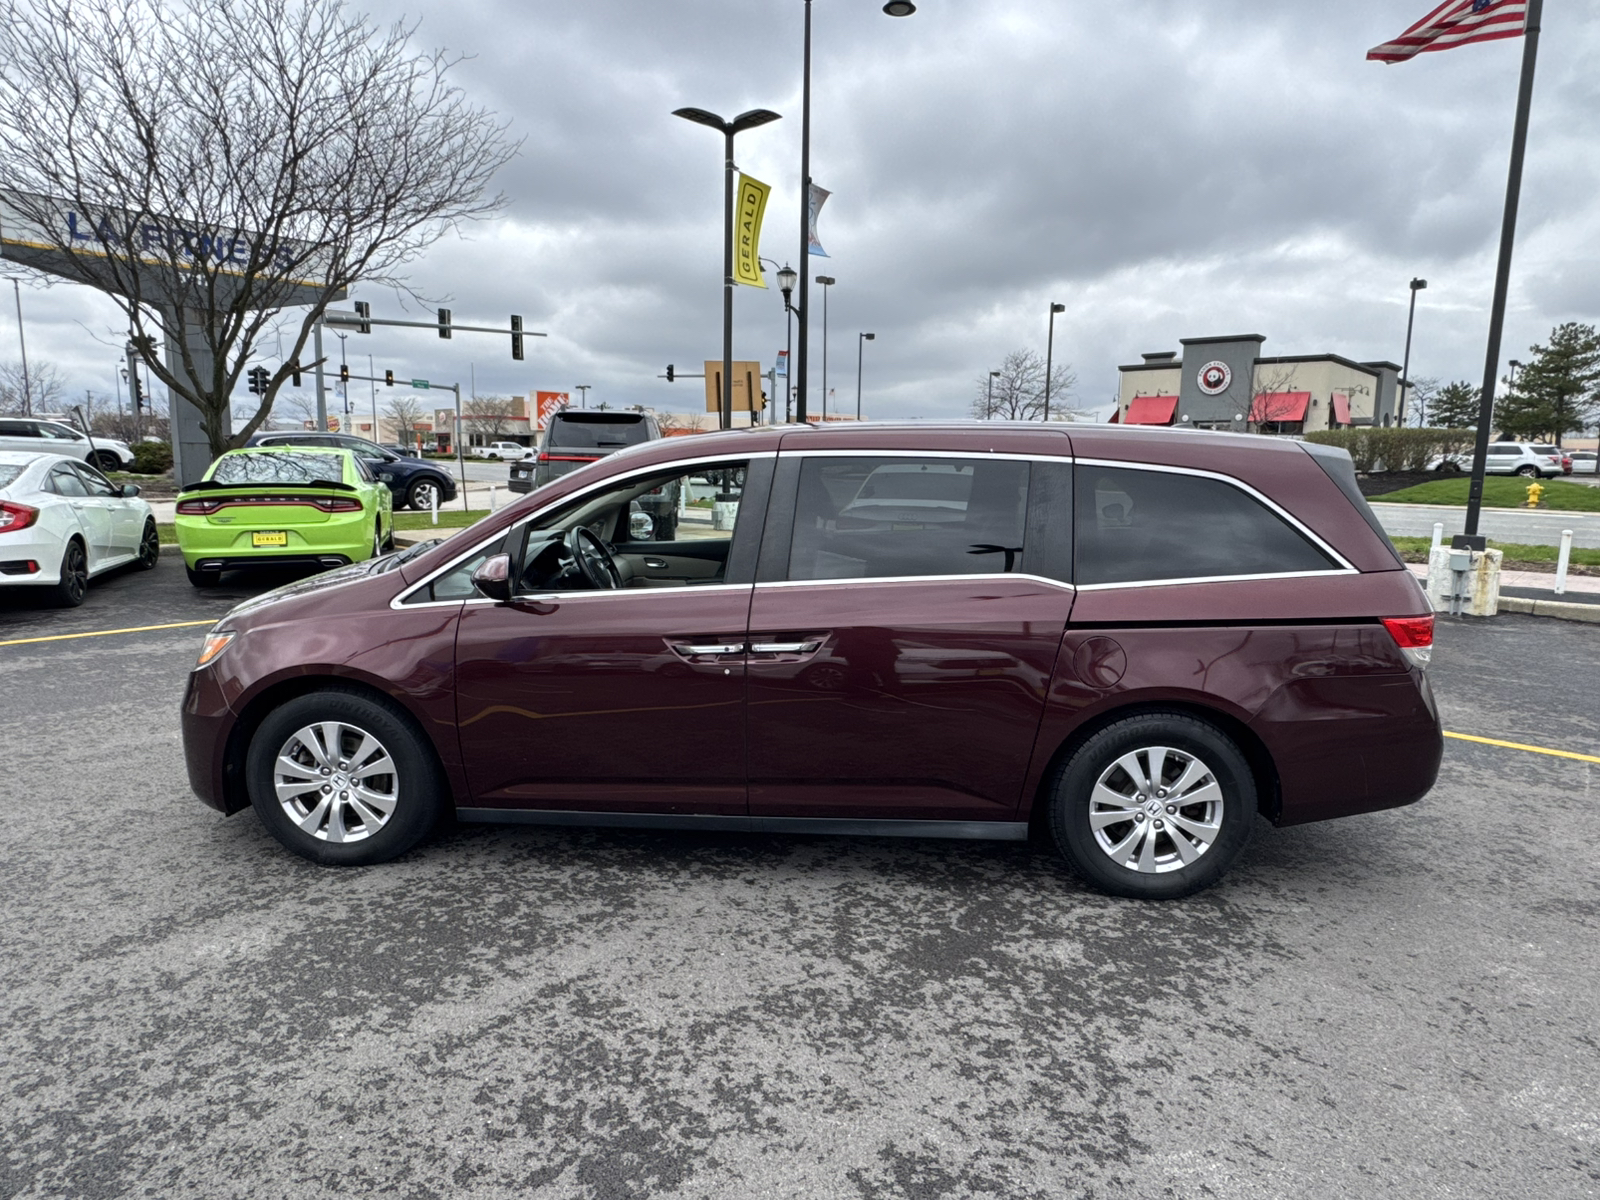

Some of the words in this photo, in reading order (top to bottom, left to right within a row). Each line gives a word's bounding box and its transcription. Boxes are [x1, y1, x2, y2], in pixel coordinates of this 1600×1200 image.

[742, 193, 756, 273] GERALD
[537, 393, 569, 428] HOME
[540, 396, 553, 411] THE
